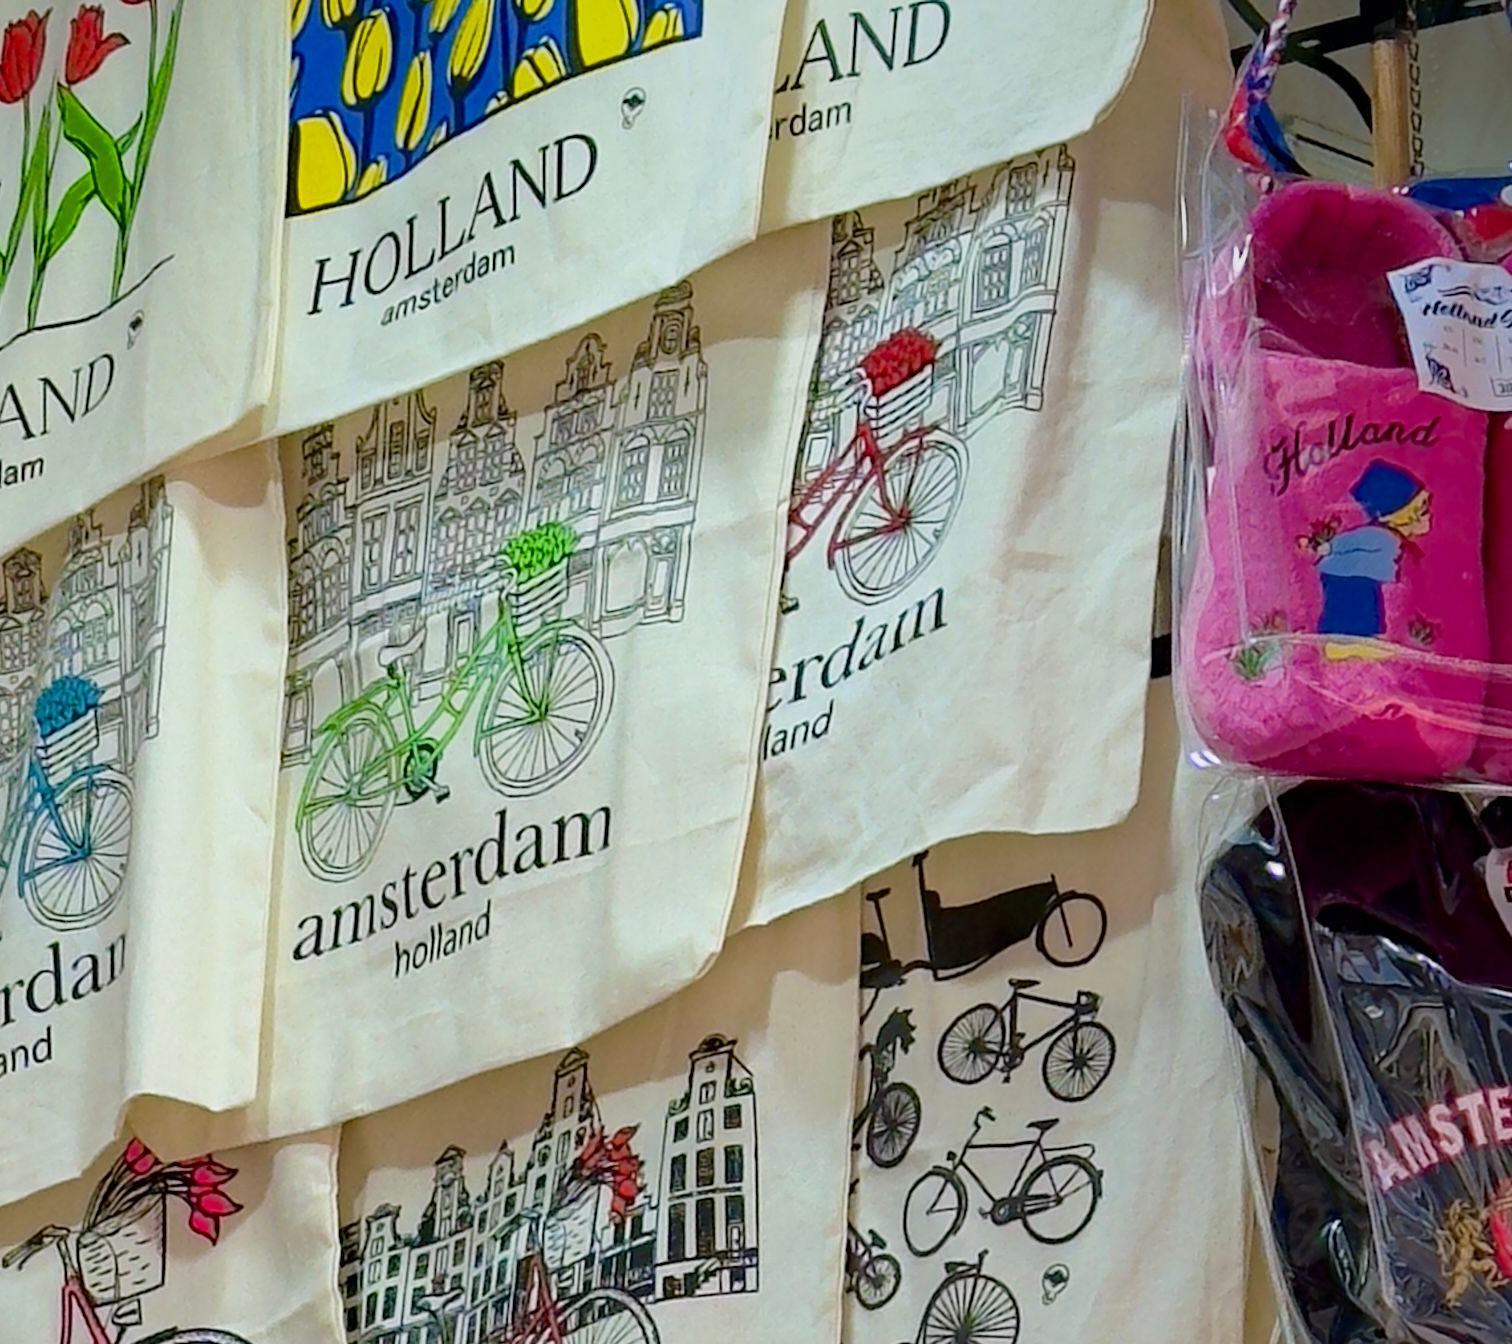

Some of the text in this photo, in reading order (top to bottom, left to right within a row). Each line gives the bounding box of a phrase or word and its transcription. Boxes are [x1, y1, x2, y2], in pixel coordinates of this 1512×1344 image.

[308, 132, 599, 315] HOLLAND
[380, 243, 515, 327] amsterdam
[1263, 415, 1440, 497] Holland
[765, 587, 948, 711] erdam
[761, 703, 833, 761] land
[293, 805, 612, 961] amsterdam
[395, 900, 491, 978] holland
[1364, 1085, 1512, 1195] AMSTE
